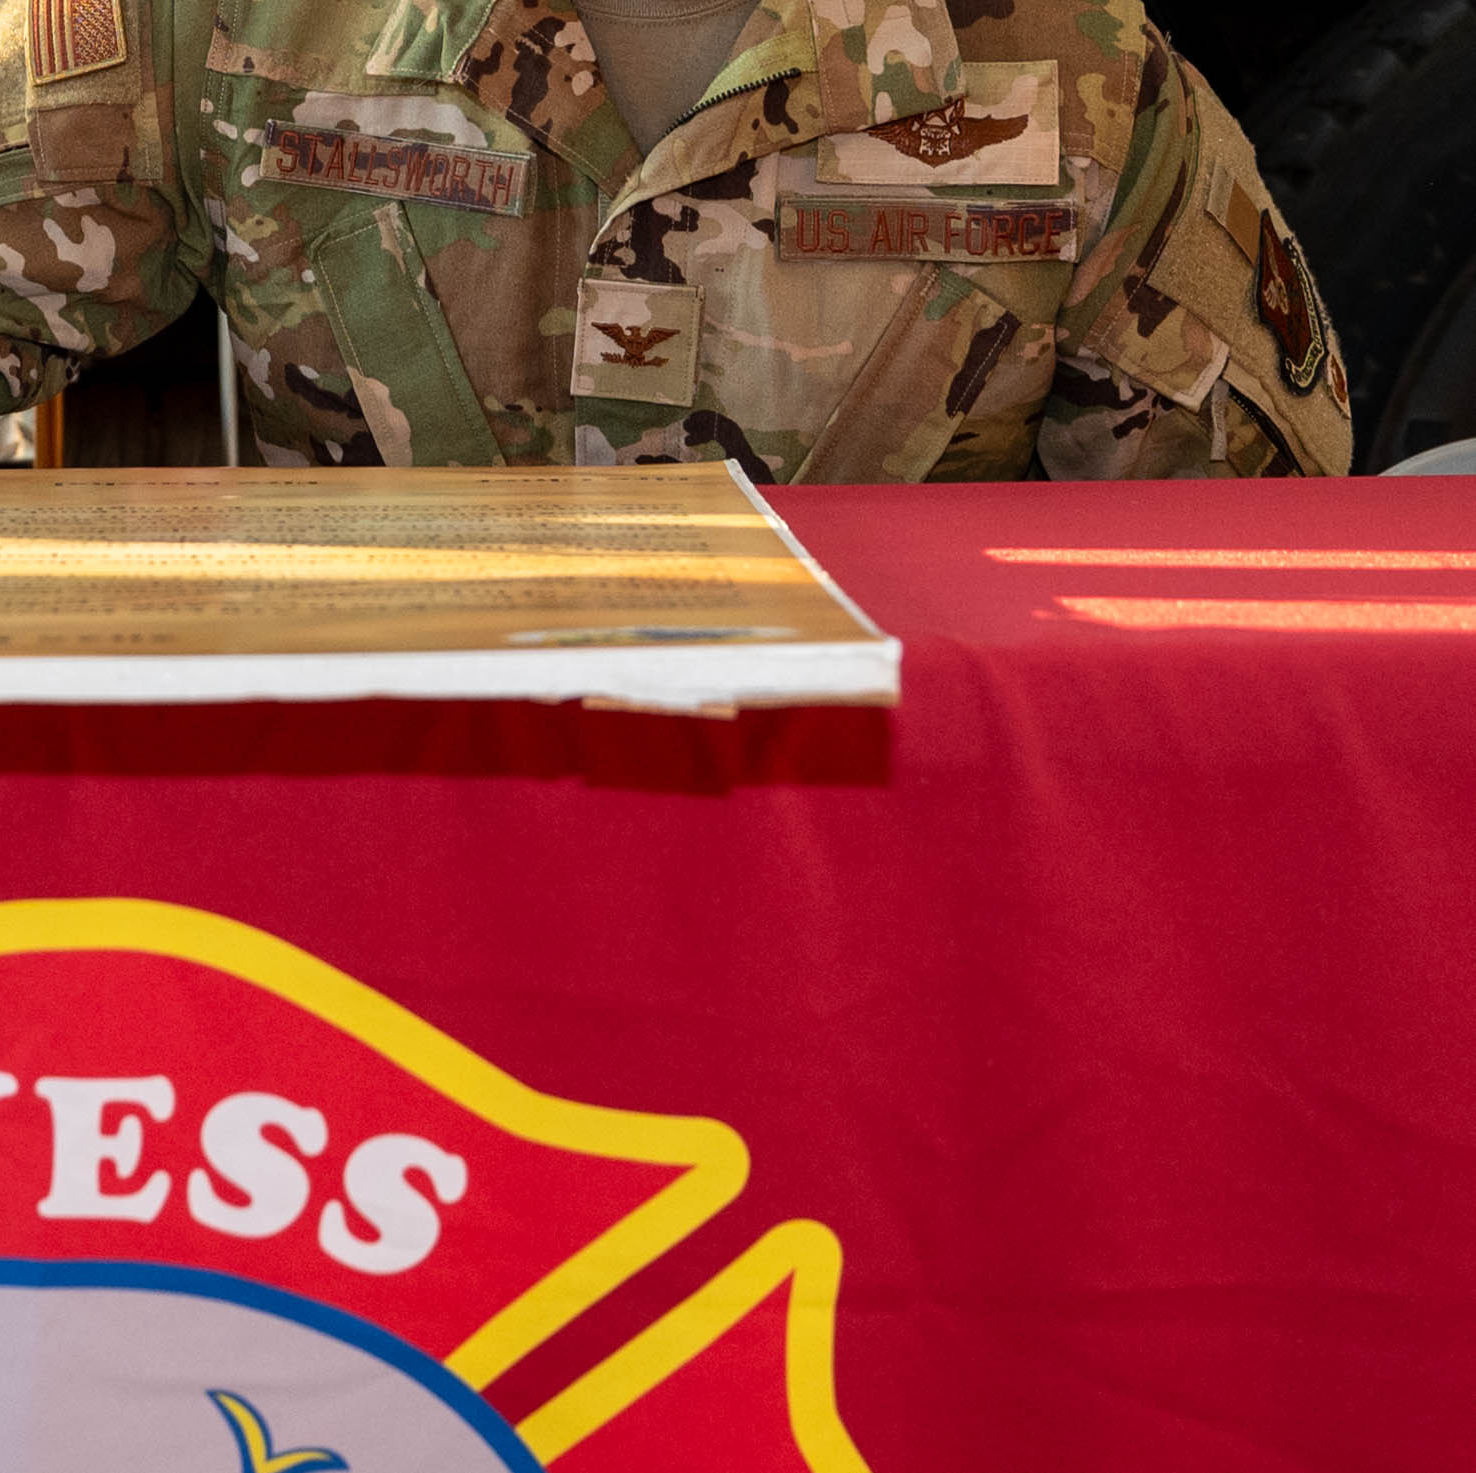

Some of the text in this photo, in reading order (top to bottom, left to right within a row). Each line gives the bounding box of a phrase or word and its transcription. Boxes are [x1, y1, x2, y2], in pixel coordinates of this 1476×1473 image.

[276, 130, 515, 206] STALLSWORTH
[871, 209, 929, 253] AIR
[943, 210, 1063, 256] FORCE
